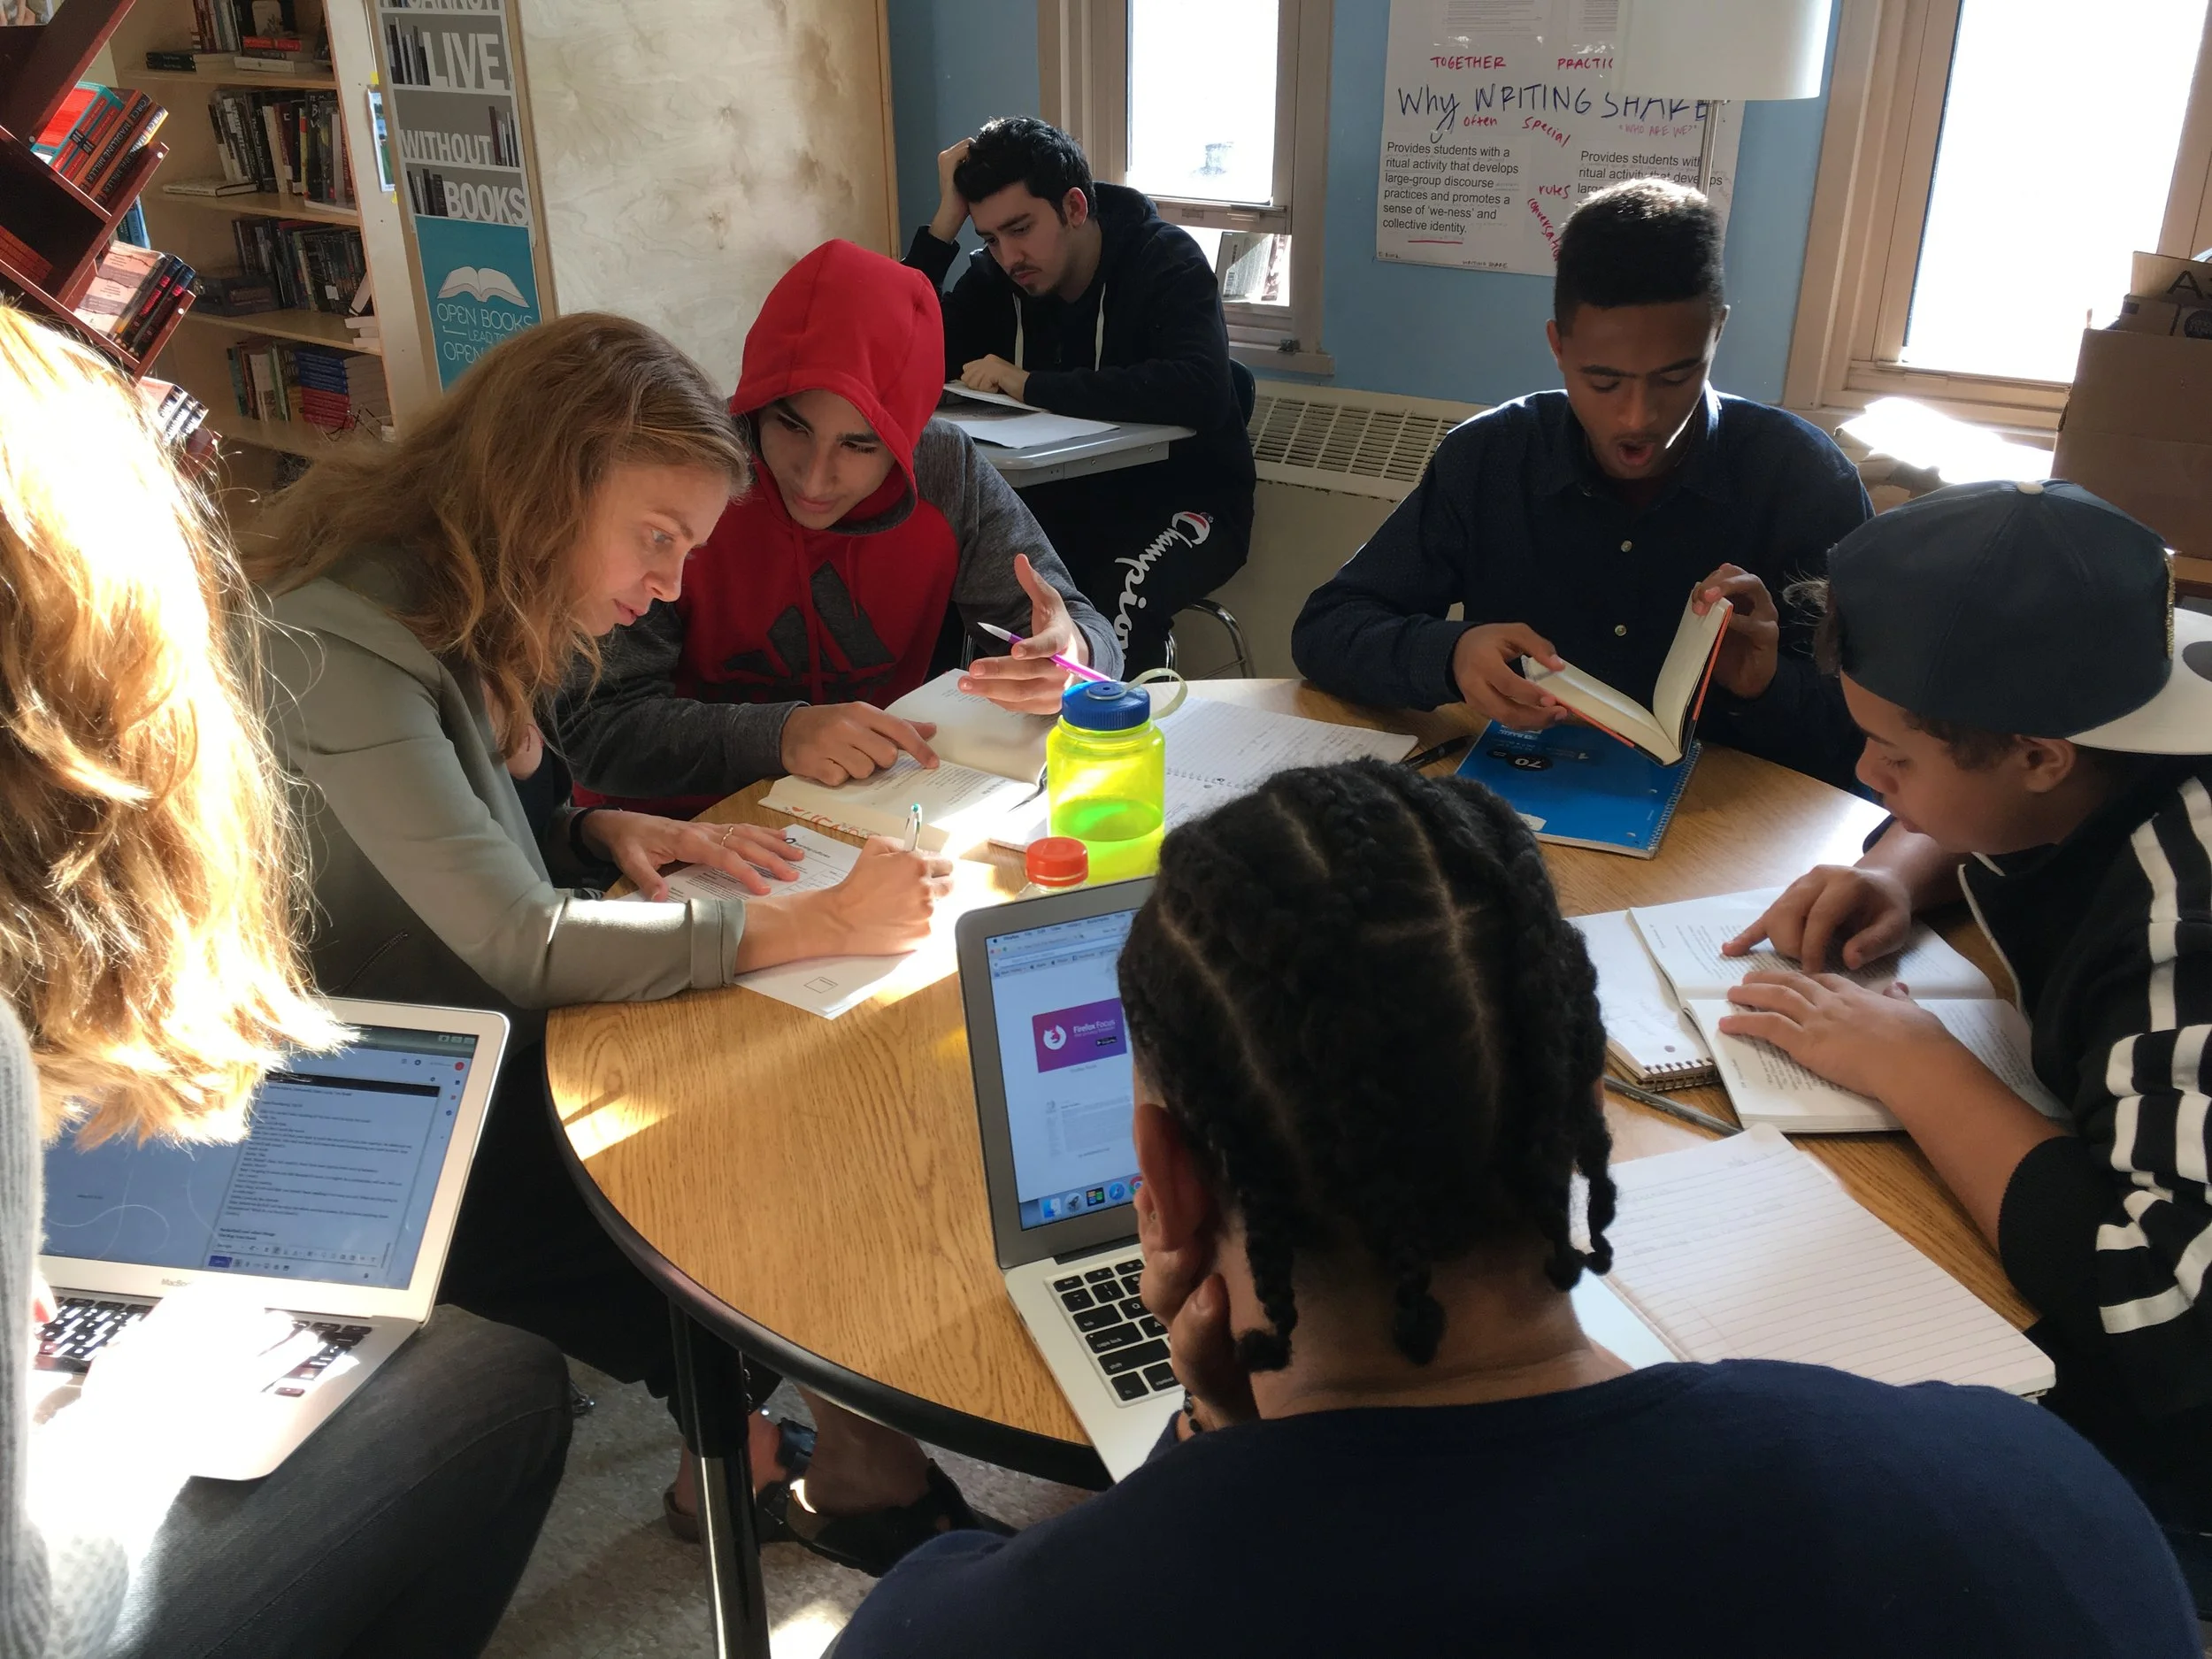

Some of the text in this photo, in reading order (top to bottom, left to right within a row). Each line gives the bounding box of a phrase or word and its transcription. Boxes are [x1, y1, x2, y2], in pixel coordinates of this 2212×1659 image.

[422, 32, 505, 89] LIVE
[1430, 56, 1506, 70] TOGETHER
[132, 99, 148, 120] CIRCE
[1398, 84, 1460, 143] Why
[1475, 83, 1591, 114] WRITING
[147, 111, 163, 133] CIRCE
[1463, 114, 1497, 127] often
[400, 129, 491, 165] WITHOUT
[1387, 142, 1510, 157] Provides students with a
[1580, 150, 1629, 164] Provides
[1632, 153, 1679, 166] students
[1386, 158, 1520, 176] ritual activity that develops
[1385, 173, 1494, 188] large-group discourse
[1578, 167, 1607, 178] ritual
[1673, 172, 1724, 188] deveps
[1384, 188, 1510, 207] practices and promotes a
[1539, 184, 1571, 199] rules
[442, 180, 529, 227] BOOKS
[1383, 204, 1413, 215] sense
[1416, 204, 1425, 215] of
[1477, 209, 1497, 220] and
[1382, 219, 1468, 235] collective identity.
[436, 303, 535, 333] OPEN BOOKS
[467, 328, 493, 344] LEAD
[1514, 757, 1541, 769] 70
